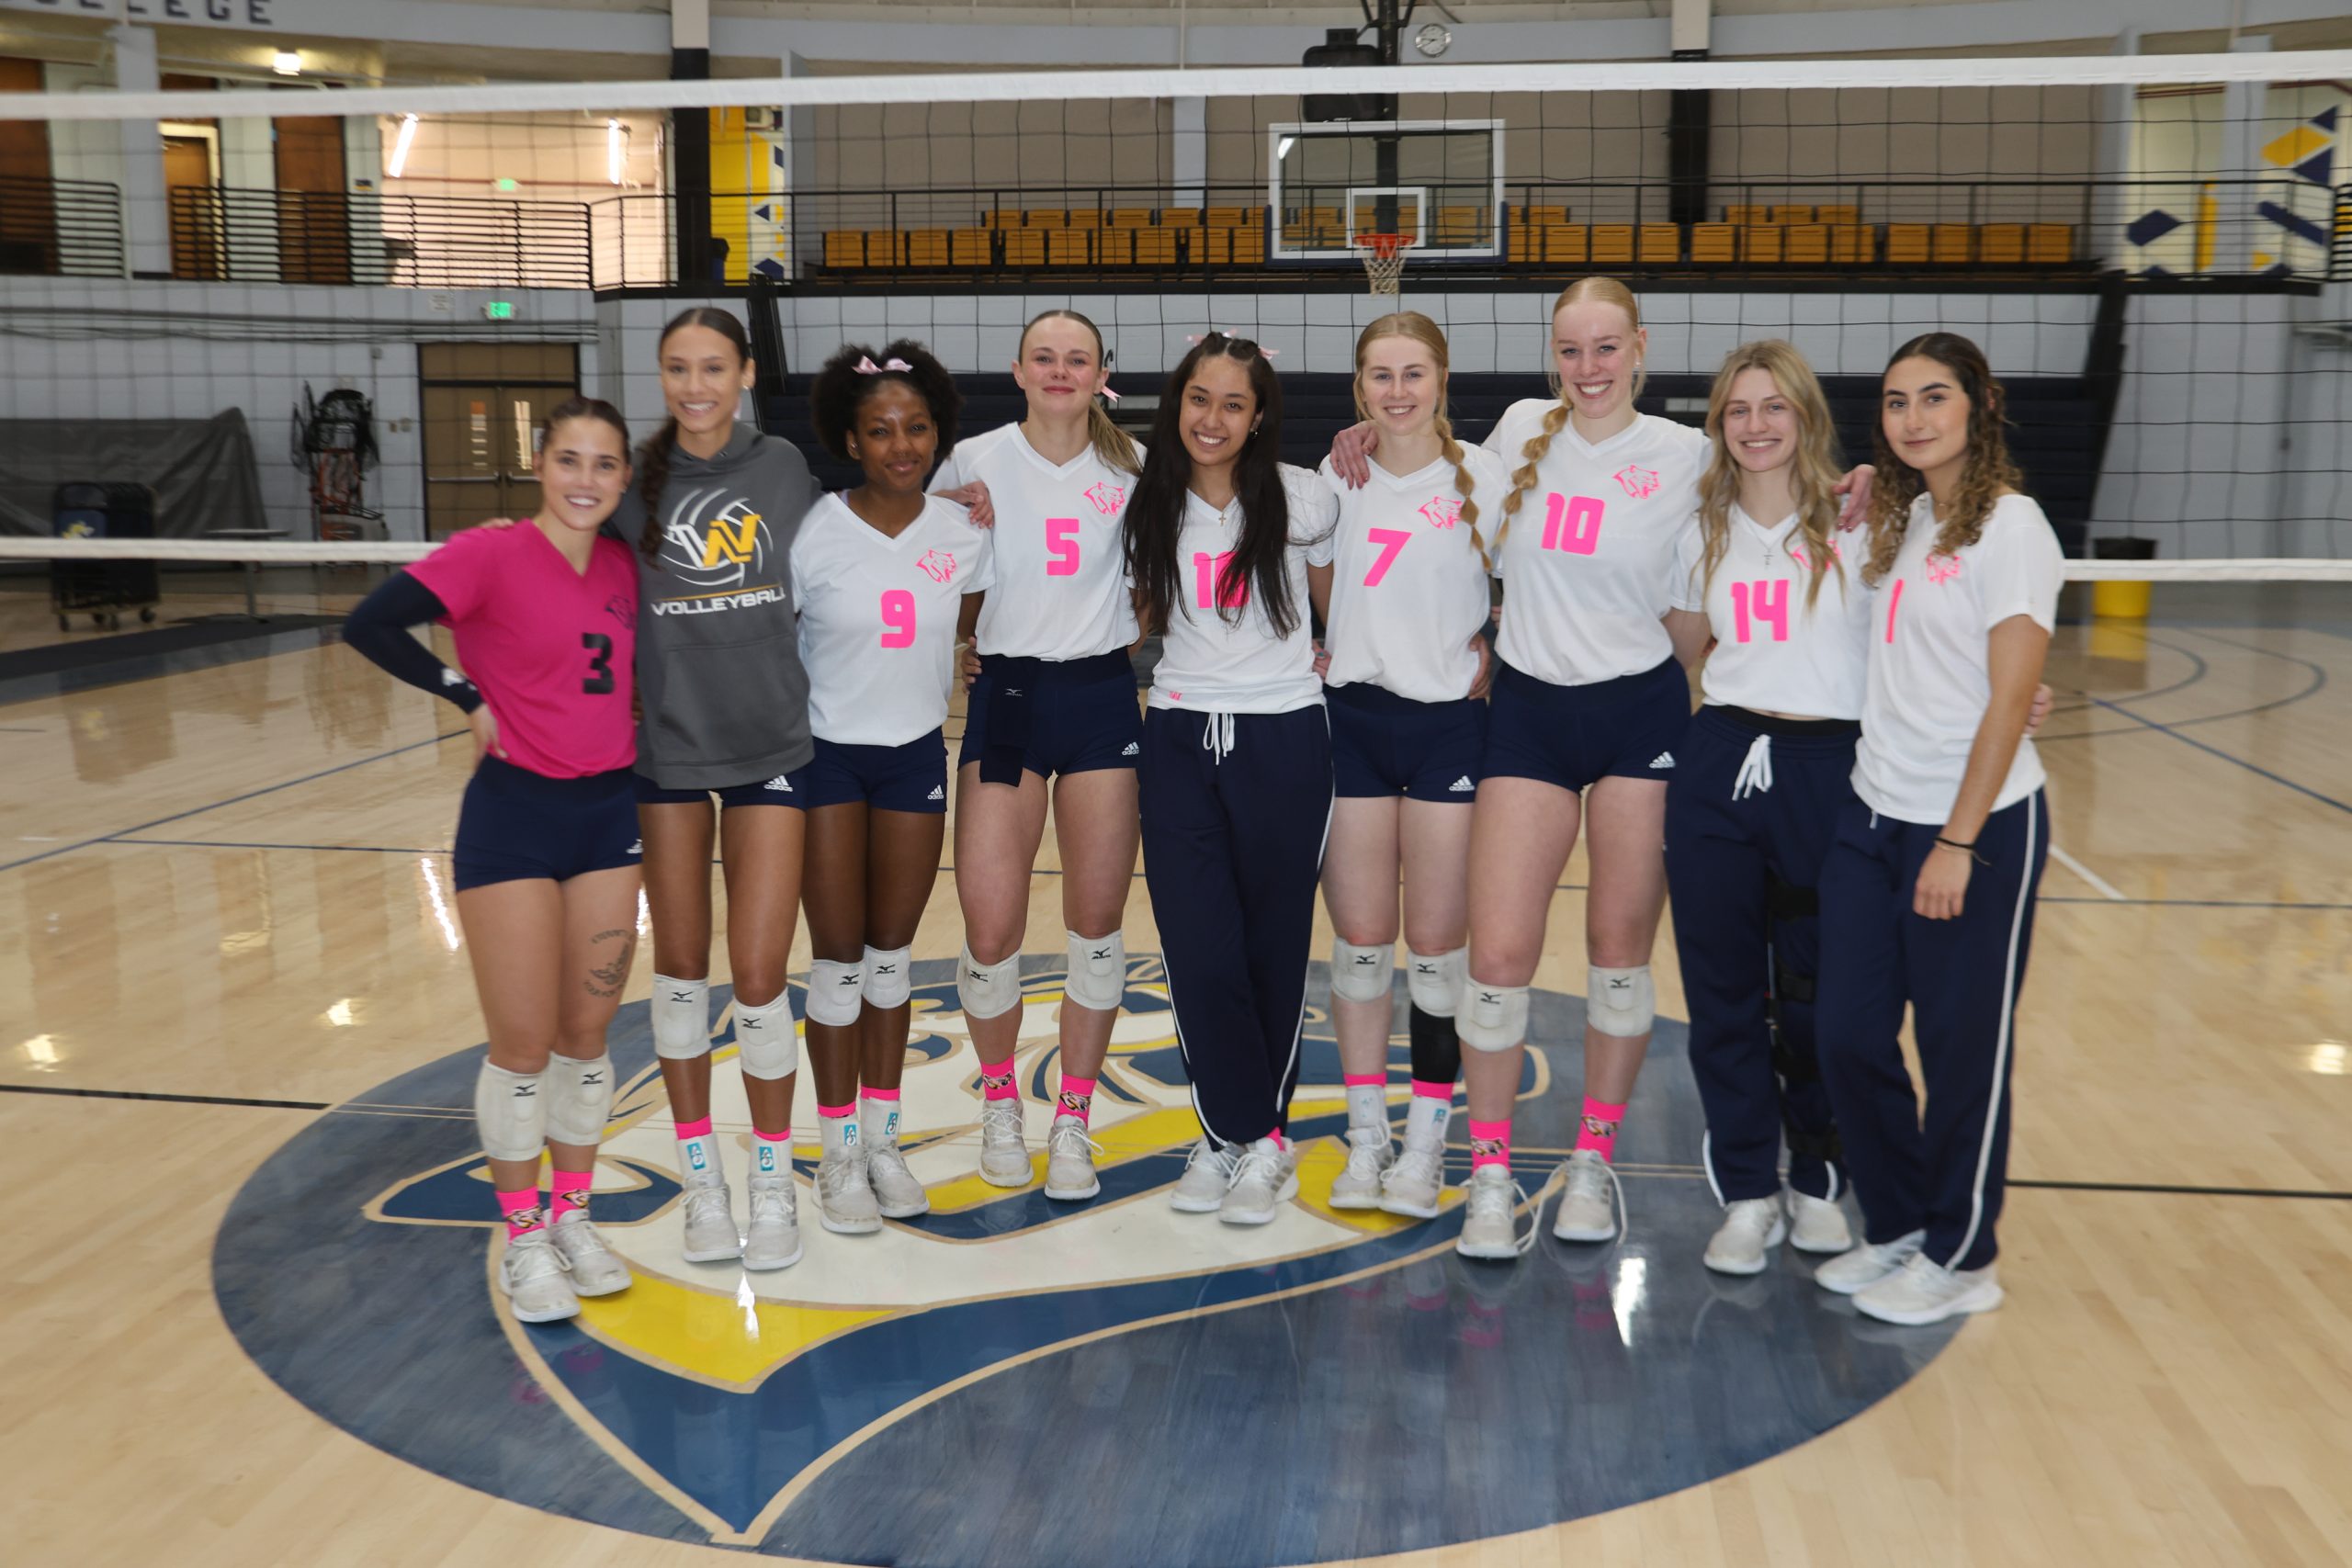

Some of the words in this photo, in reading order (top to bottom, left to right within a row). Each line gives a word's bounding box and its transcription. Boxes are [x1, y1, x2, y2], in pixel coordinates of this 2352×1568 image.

[35, 0, 273, 25] LEGE
[1046, 518, 1080, 577] 5
[1541, 492, 1606, 556] 10
[1363, 527, 1412, 588] 7
[650, 587, 786, 616] VOLLEYBALL
[880, 589, 916, 649] 9
[1731, 579, 1790, 643] 14
[582, 632, 615, 694] 3
